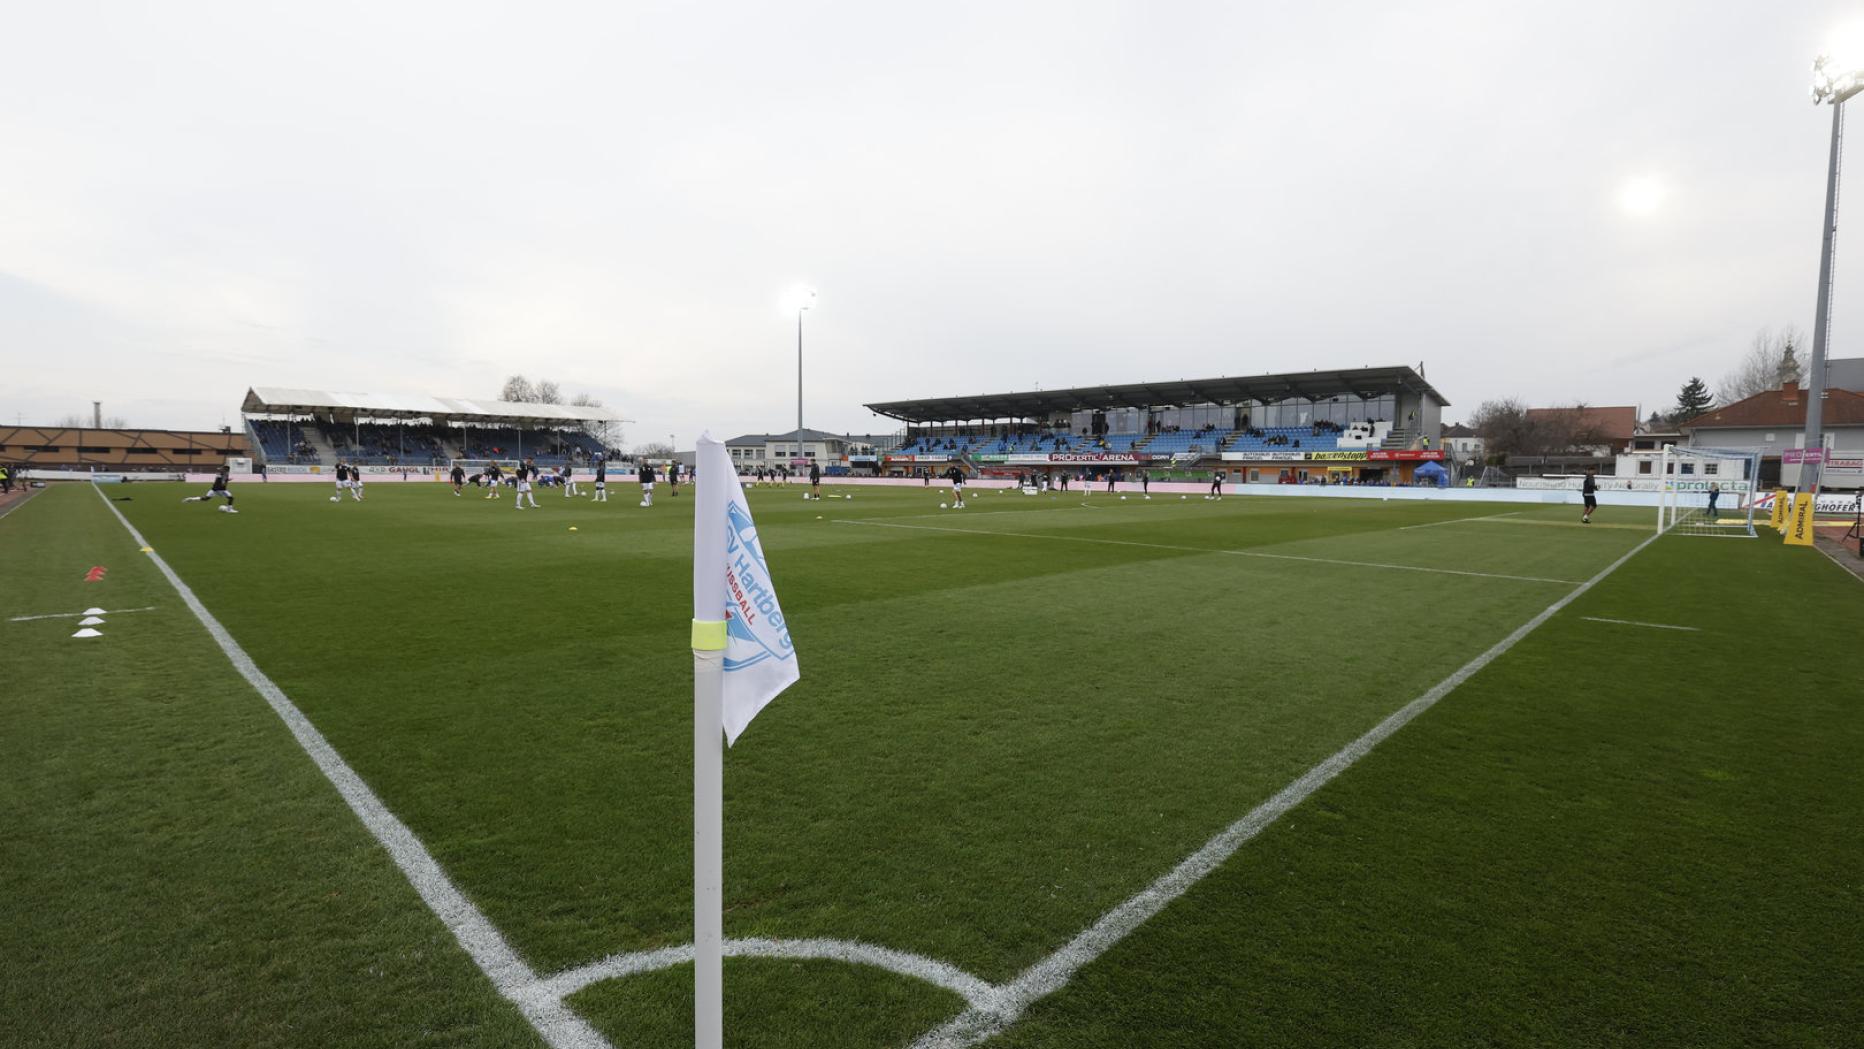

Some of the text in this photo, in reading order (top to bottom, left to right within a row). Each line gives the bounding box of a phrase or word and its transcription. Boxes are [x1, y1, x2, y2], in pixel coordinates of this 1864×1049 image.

[1102, 453, 1135, 461] ARENA
[1795, 501, 1808, 540] ADMIRAL
[727, 565, 756, 626] USSBALL
[735, 554, 792, 650] Hartberg
